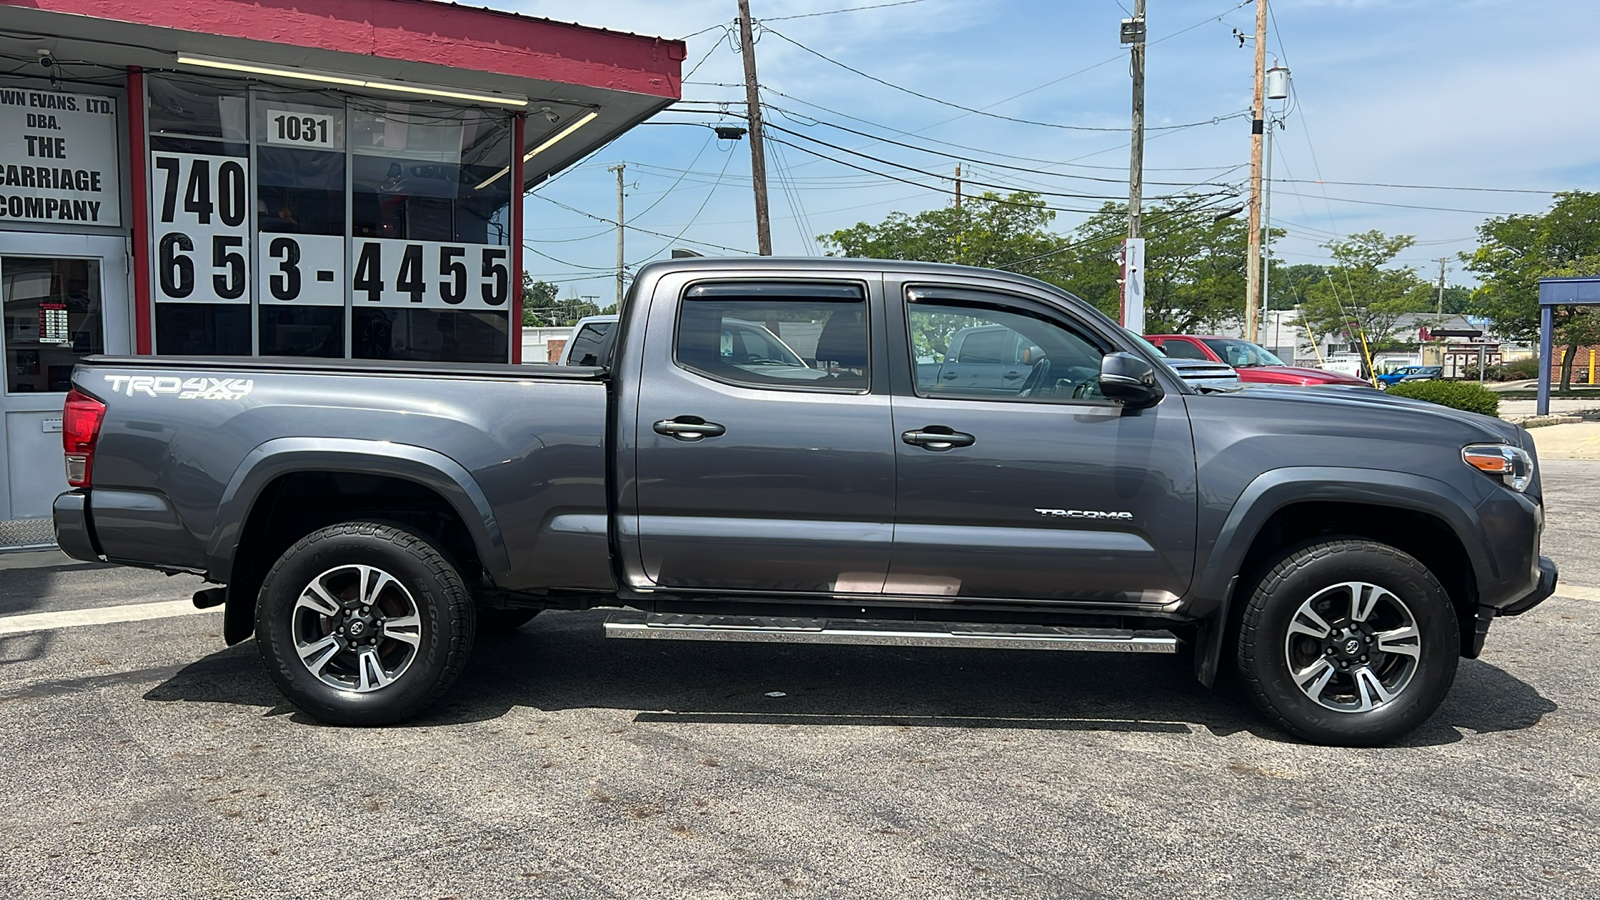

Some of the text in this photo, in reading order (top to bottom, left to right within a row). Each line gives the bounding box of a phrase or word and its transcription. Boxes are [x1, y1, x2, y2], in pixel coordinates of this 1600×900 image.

[29, 93, 80, 112] EVANS.
[87, 99, 114, 115] LTD.
[26, 113, 61, 130] DBA.
[274, 115, 328, 143] 1031
[24, 135, 66, 159] THE
[156, 156, 246, 228] 740
[104, 375, 182, 398] TRD
[178, 390, 245, 400] SPORT
[1034, 508, 1133, 520] TACOMA
